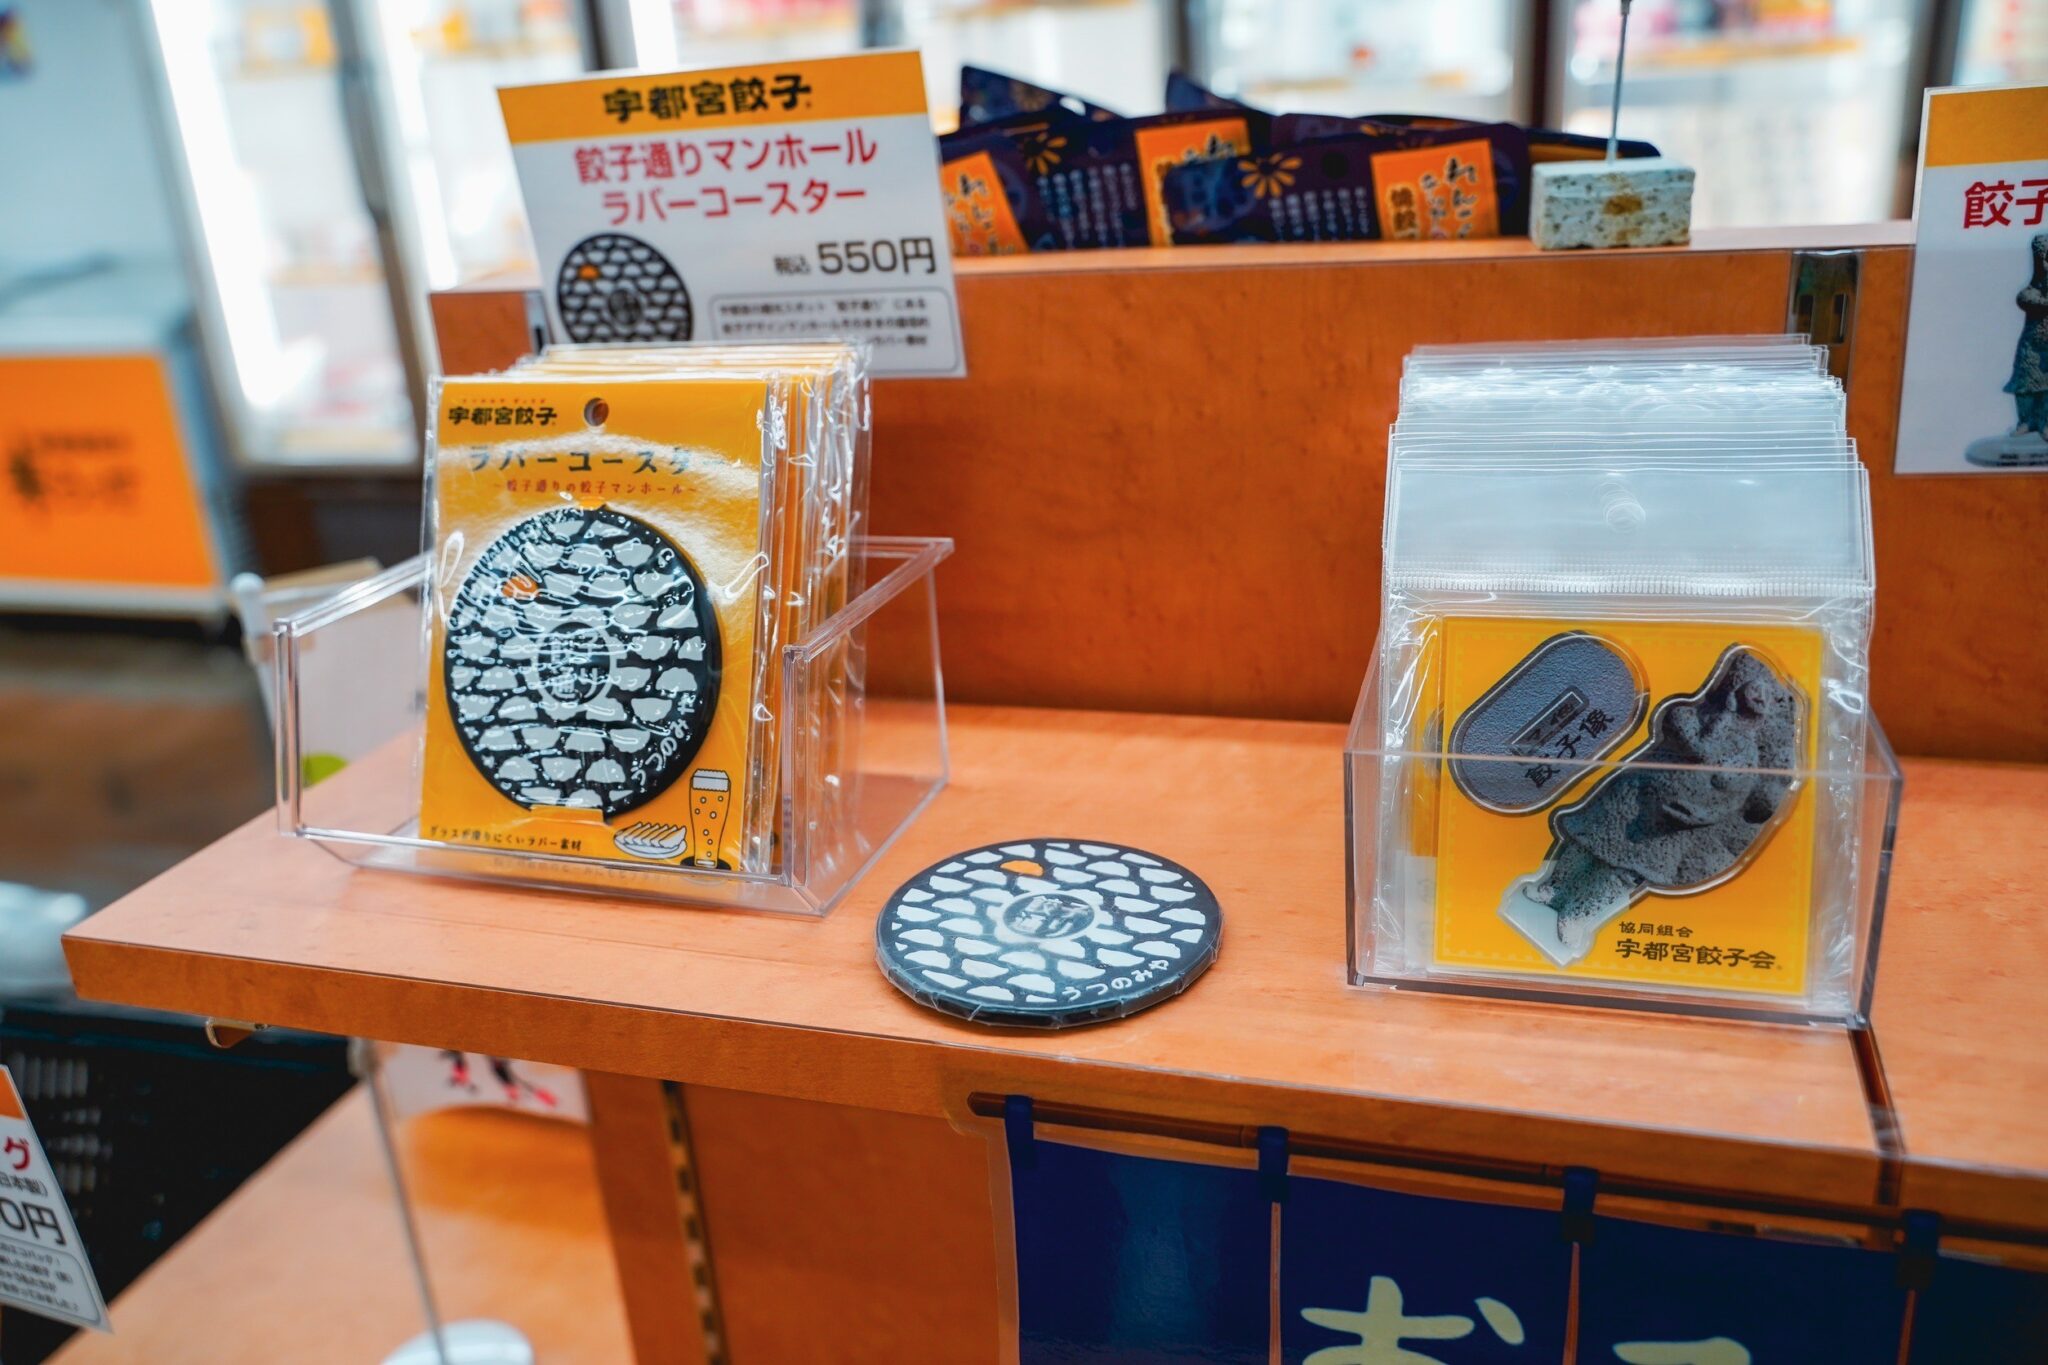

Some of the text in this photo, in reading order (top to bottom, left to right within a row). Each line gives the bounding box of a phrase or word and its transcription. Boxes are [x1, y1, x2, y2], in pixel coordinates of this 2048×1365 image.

[603, 73, 811, 123] 宇都宮餃子
[574, 128, 877, 184] 餃子通りマンホール
[602, 178, 867, 226] ラバーコースター
[817, 237, 937, 277] 550円
[448, 405, 558, 426] 宇都宮餃子
[1524, 709, 1615, 789] 餃子像
[1618, 921, 1694, 939] 協同組合
[1615, 938, 1777, 971] 宇都宮餃子会
[1061, 959, 1170, 1002] うつのみや
